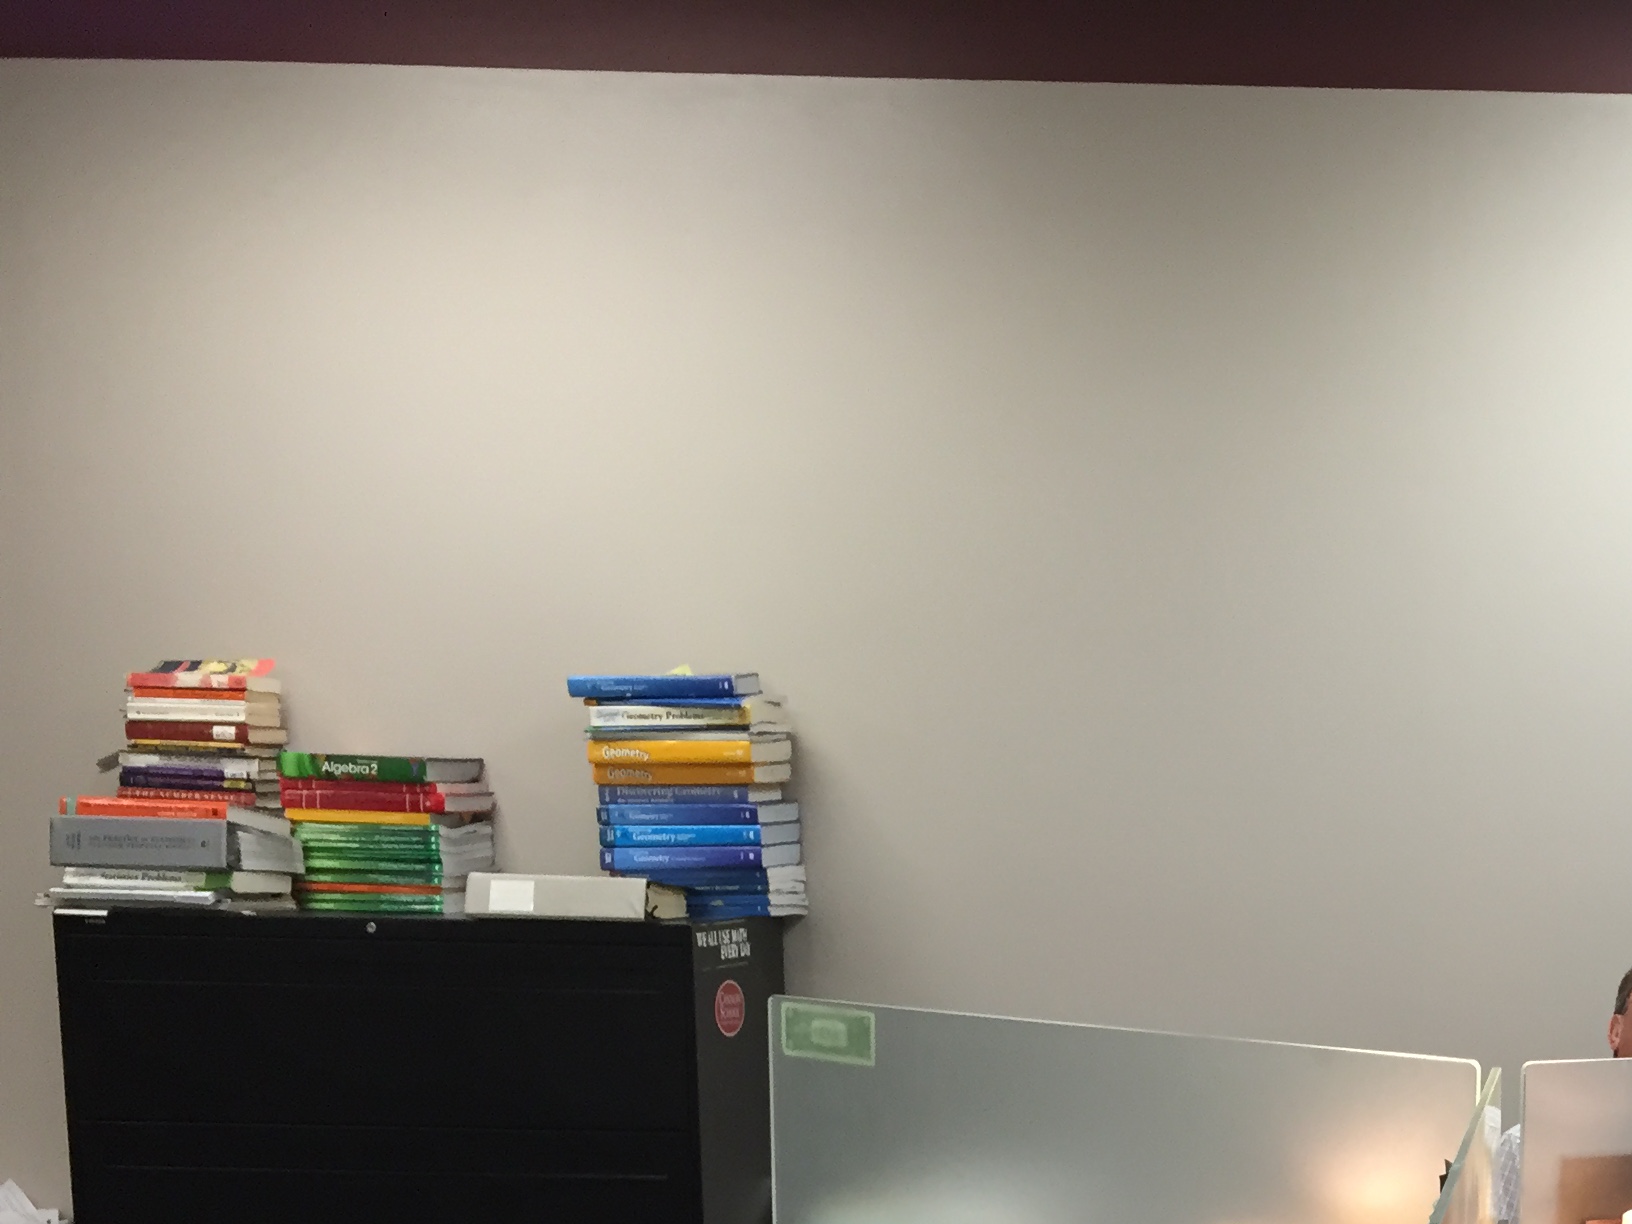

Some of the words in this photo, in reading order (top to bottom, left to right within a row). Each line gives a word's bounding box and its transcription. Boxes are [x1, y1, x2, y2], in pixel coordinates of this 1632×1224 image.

[602, 746, 649, 761] Geometry
[321, 761, 369, 776] Algebra
[370, 763, 378, 775] 2
[607, 767, 652, 780] Geometry
[696, 931, 707, 948] WE
[707, 930, 718, 947] ALL
[718, 929, 731, 946] USE
[731, 928, 748, 943] MATH
[720, 943, 739, 961] EVERY
